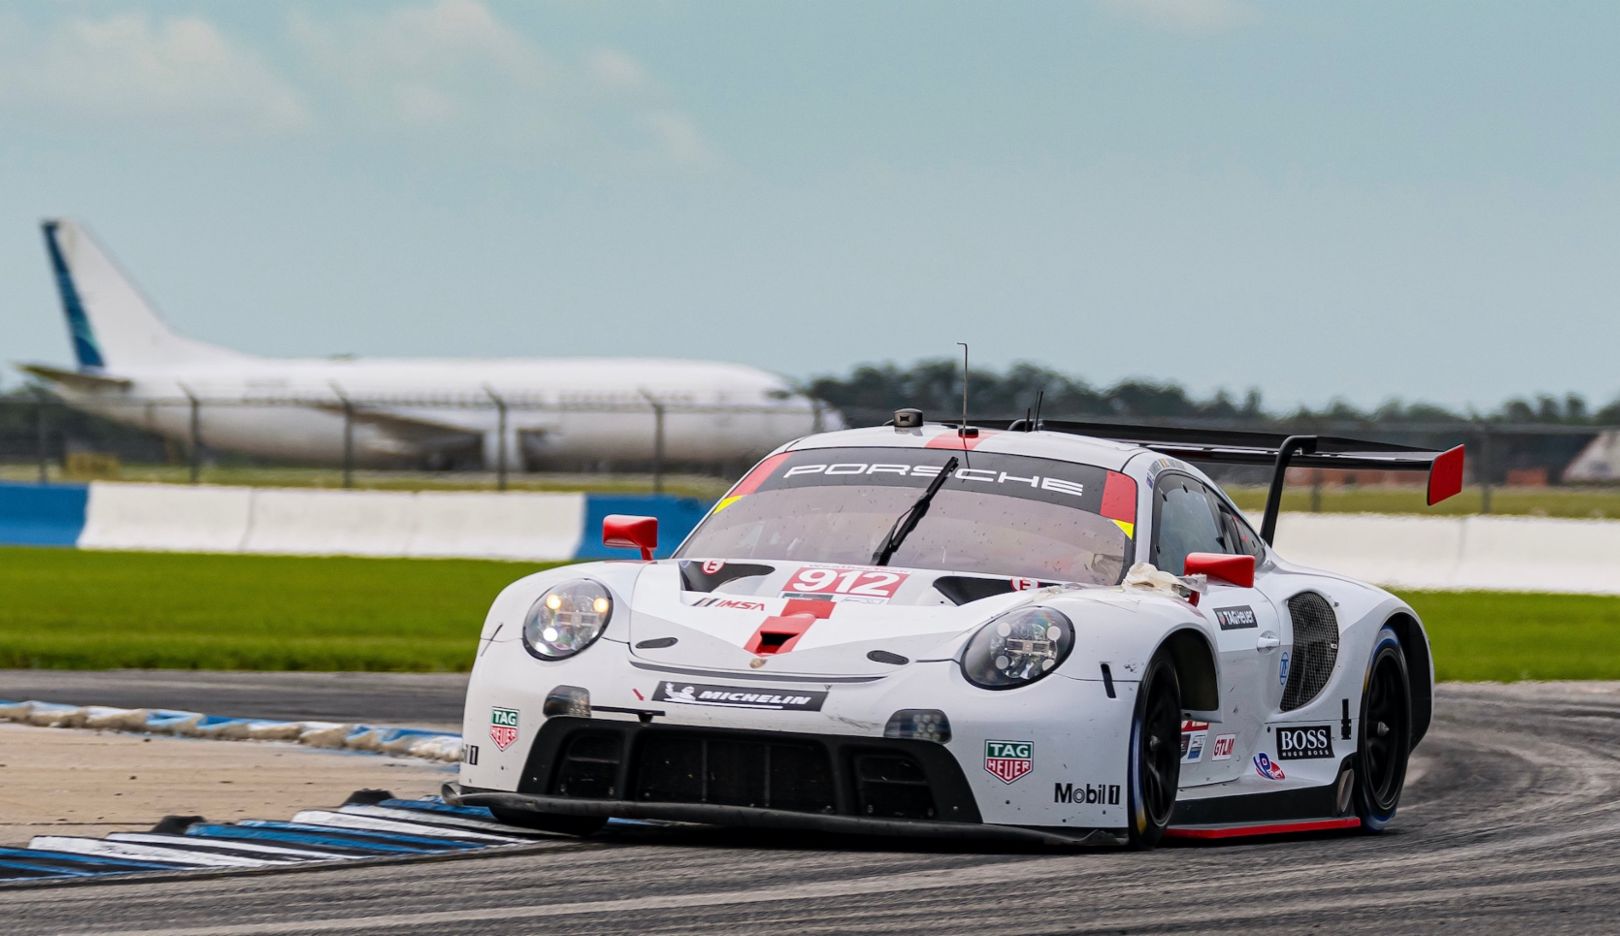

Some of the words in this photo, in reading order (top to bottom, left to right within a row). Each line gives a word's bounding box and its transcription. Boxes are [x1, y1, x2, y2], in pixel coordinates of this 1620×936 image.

[783, 463, 1083, 496] PORSCHE
[792, 569, 900, 596] 912
[715, 599, 765, 611] IMSA
[699, 691, 811, 705] MICHELIN
[493, 711, 517, 725] TAG
[1213, 738, 1235, 757] GTLM
[1280, 729, 1328, 750] BOSS
[989, 743, 1029, 757] TAG
[988, 760, 1030, 780] HEUER
[1054, 782, 1106, 804] Mobil
